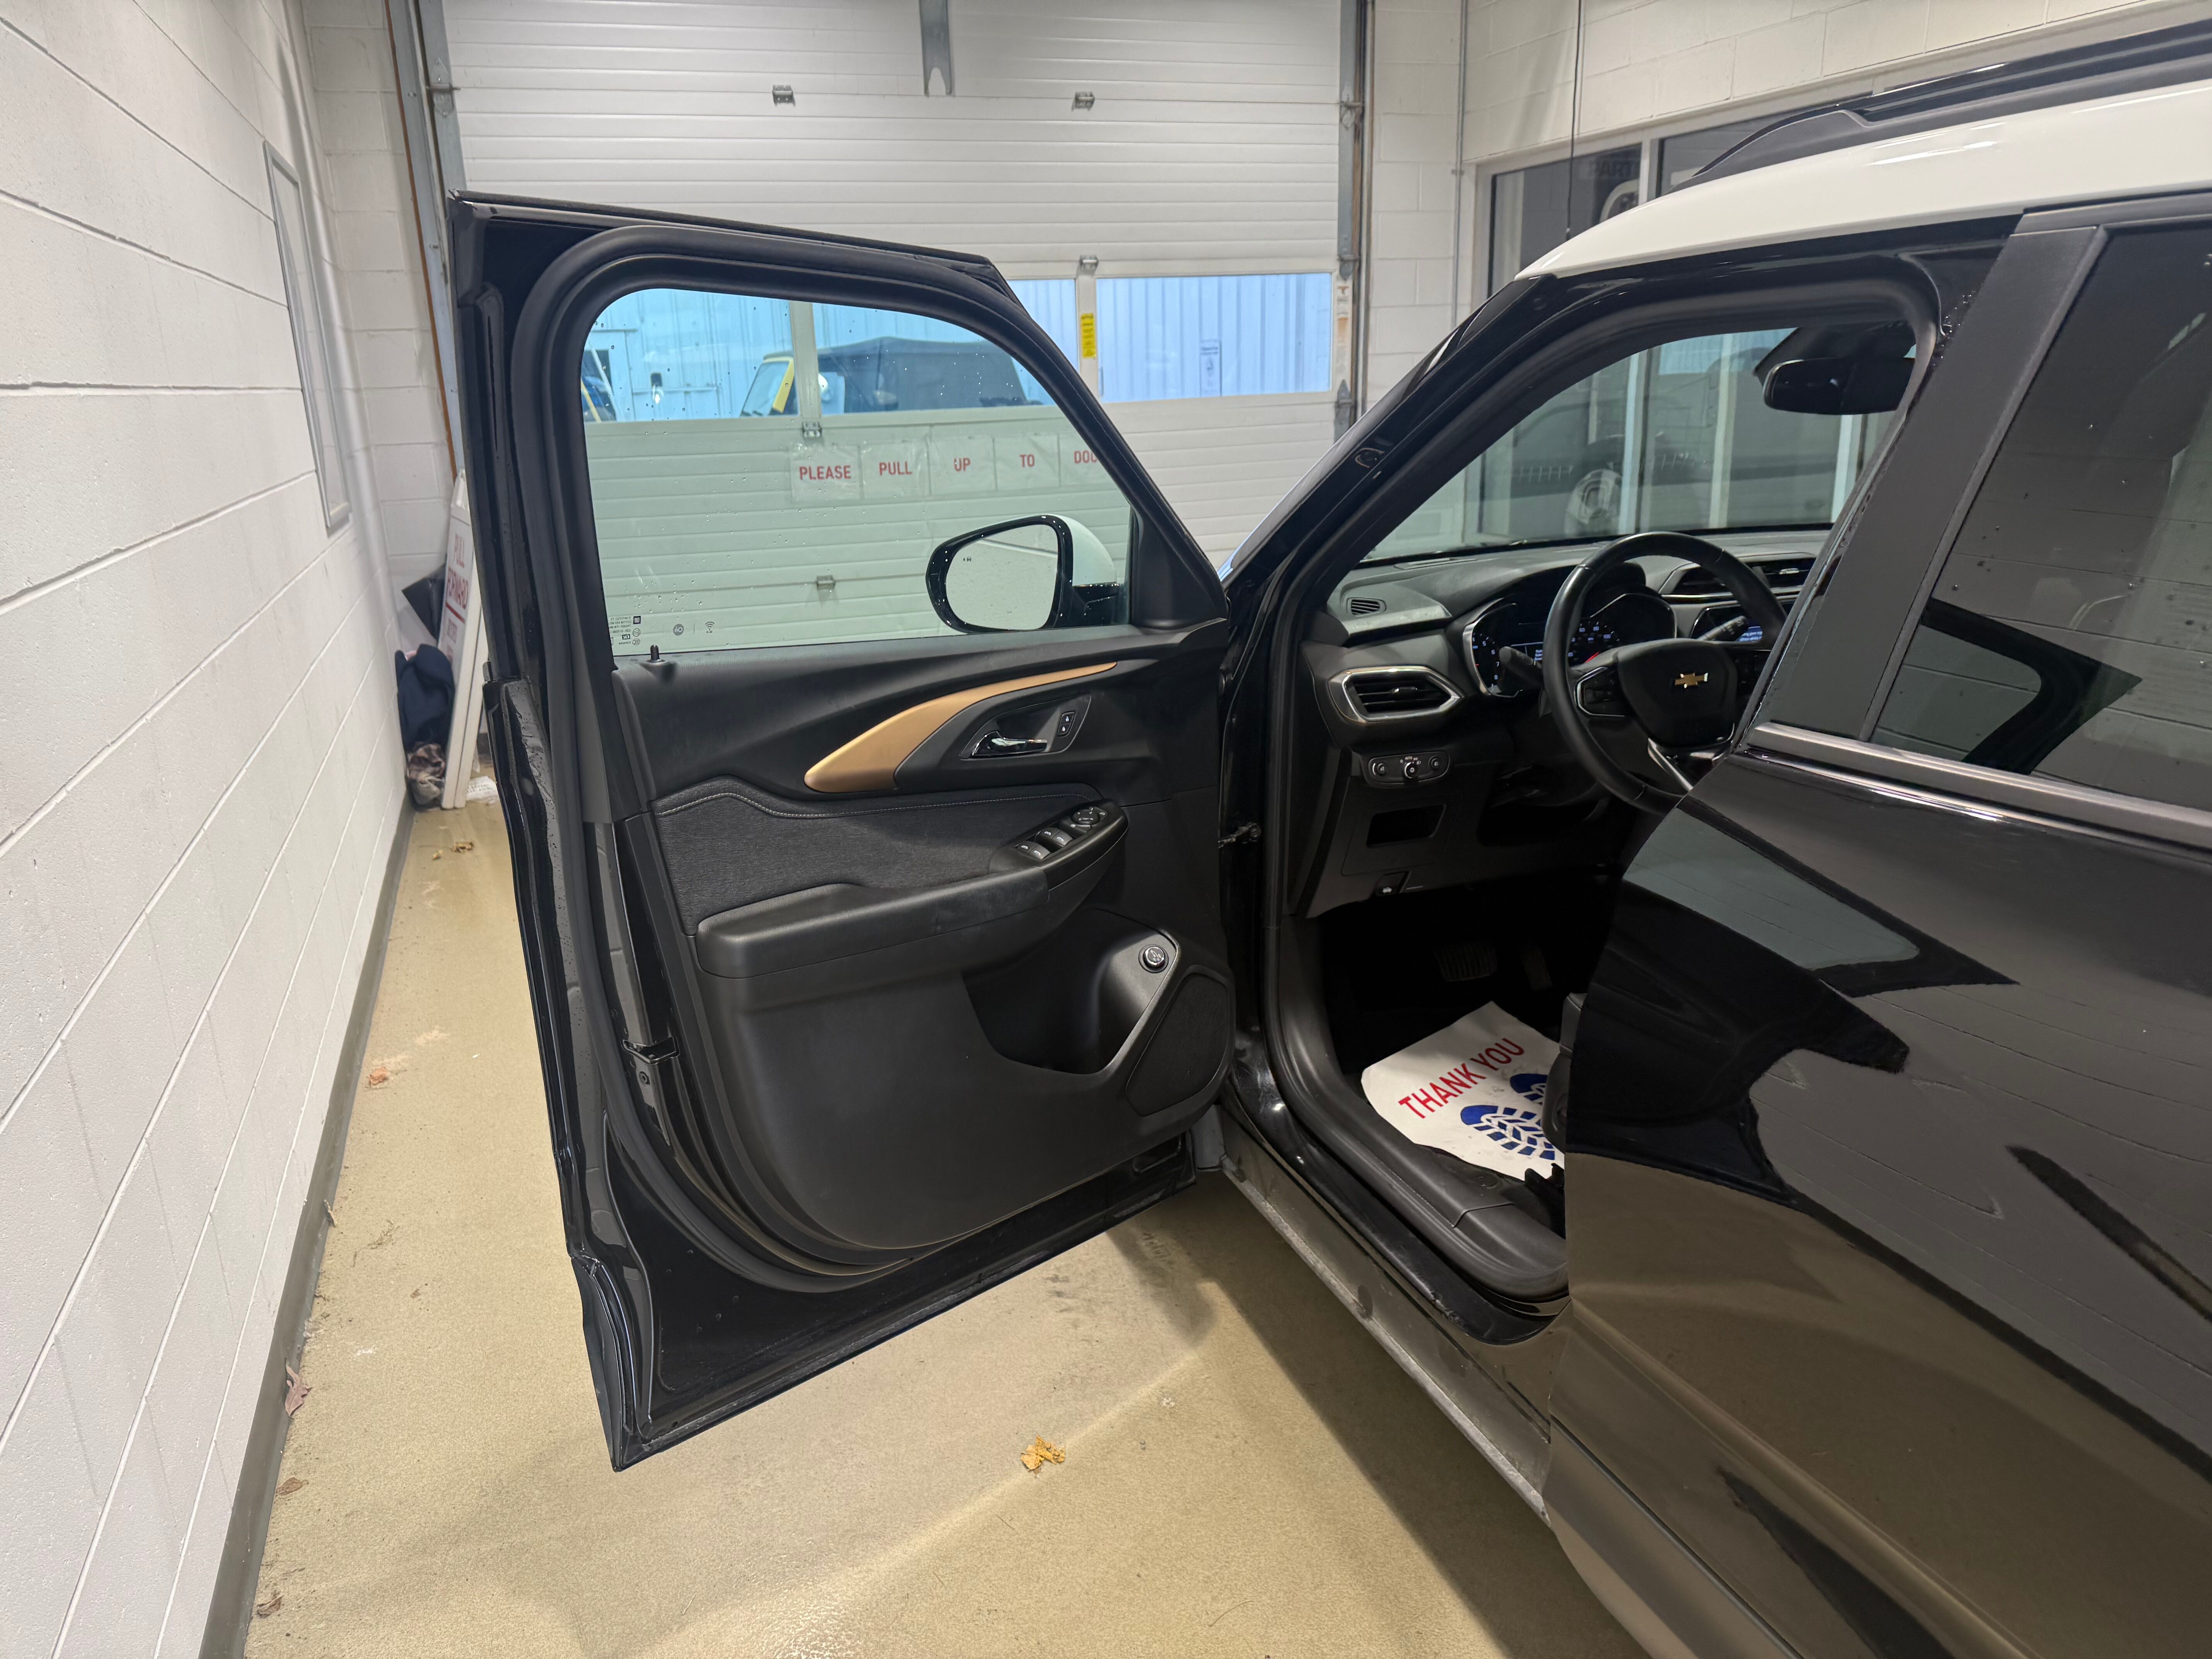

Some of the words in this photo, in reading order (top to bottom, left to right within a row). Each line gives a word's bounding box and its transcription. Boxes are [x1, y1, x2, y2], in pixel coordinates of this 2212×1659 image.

[799, 465, 852, 480] PLEASE
[879, 462, 913, 475] PULL
[953, 458, 971, 471] UP
[1019, 453, 1035, 467] TO
[454, 533, 464, 568] PULL
[446, 565, 468, 610] FORWARD
[1398, 1063, 1487, 1119] THANK
[1470, 1037, 1525, 1071] YOU
